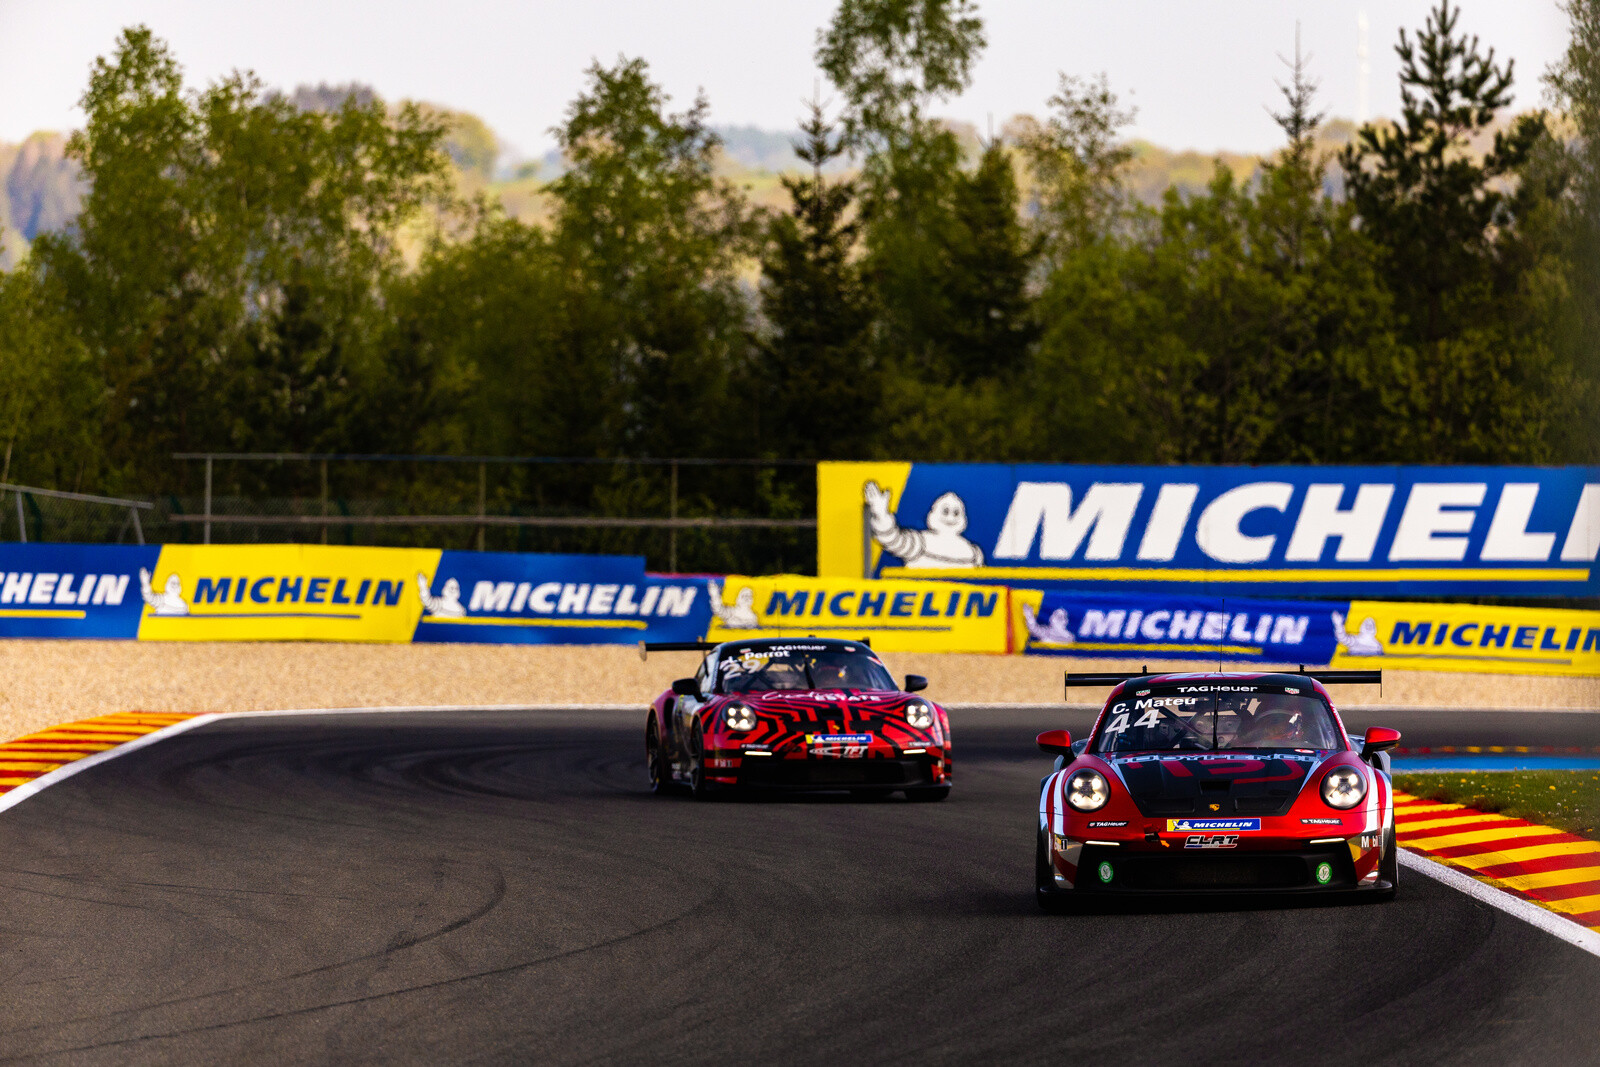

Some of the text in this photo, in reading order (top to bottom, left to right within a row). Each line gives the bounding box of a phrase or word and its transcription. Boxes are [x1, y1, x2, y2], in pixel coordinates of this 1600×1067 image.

[193, 577, 404, 606] MICHELIN
[469, 581, 698, 618] MICHELIN
[765, 588, 999, 618] MICHELIN
[1079, 609, 1310, 645] MICHELIN
[744, 650, 791, 659] Perrot
[723, 659, 761, 680] 29
[1112, 697, 1197, 715] C. Mateu
[1104, 709, 1161, 734] 44
[1185, 835, 1239, 846] CLRT
